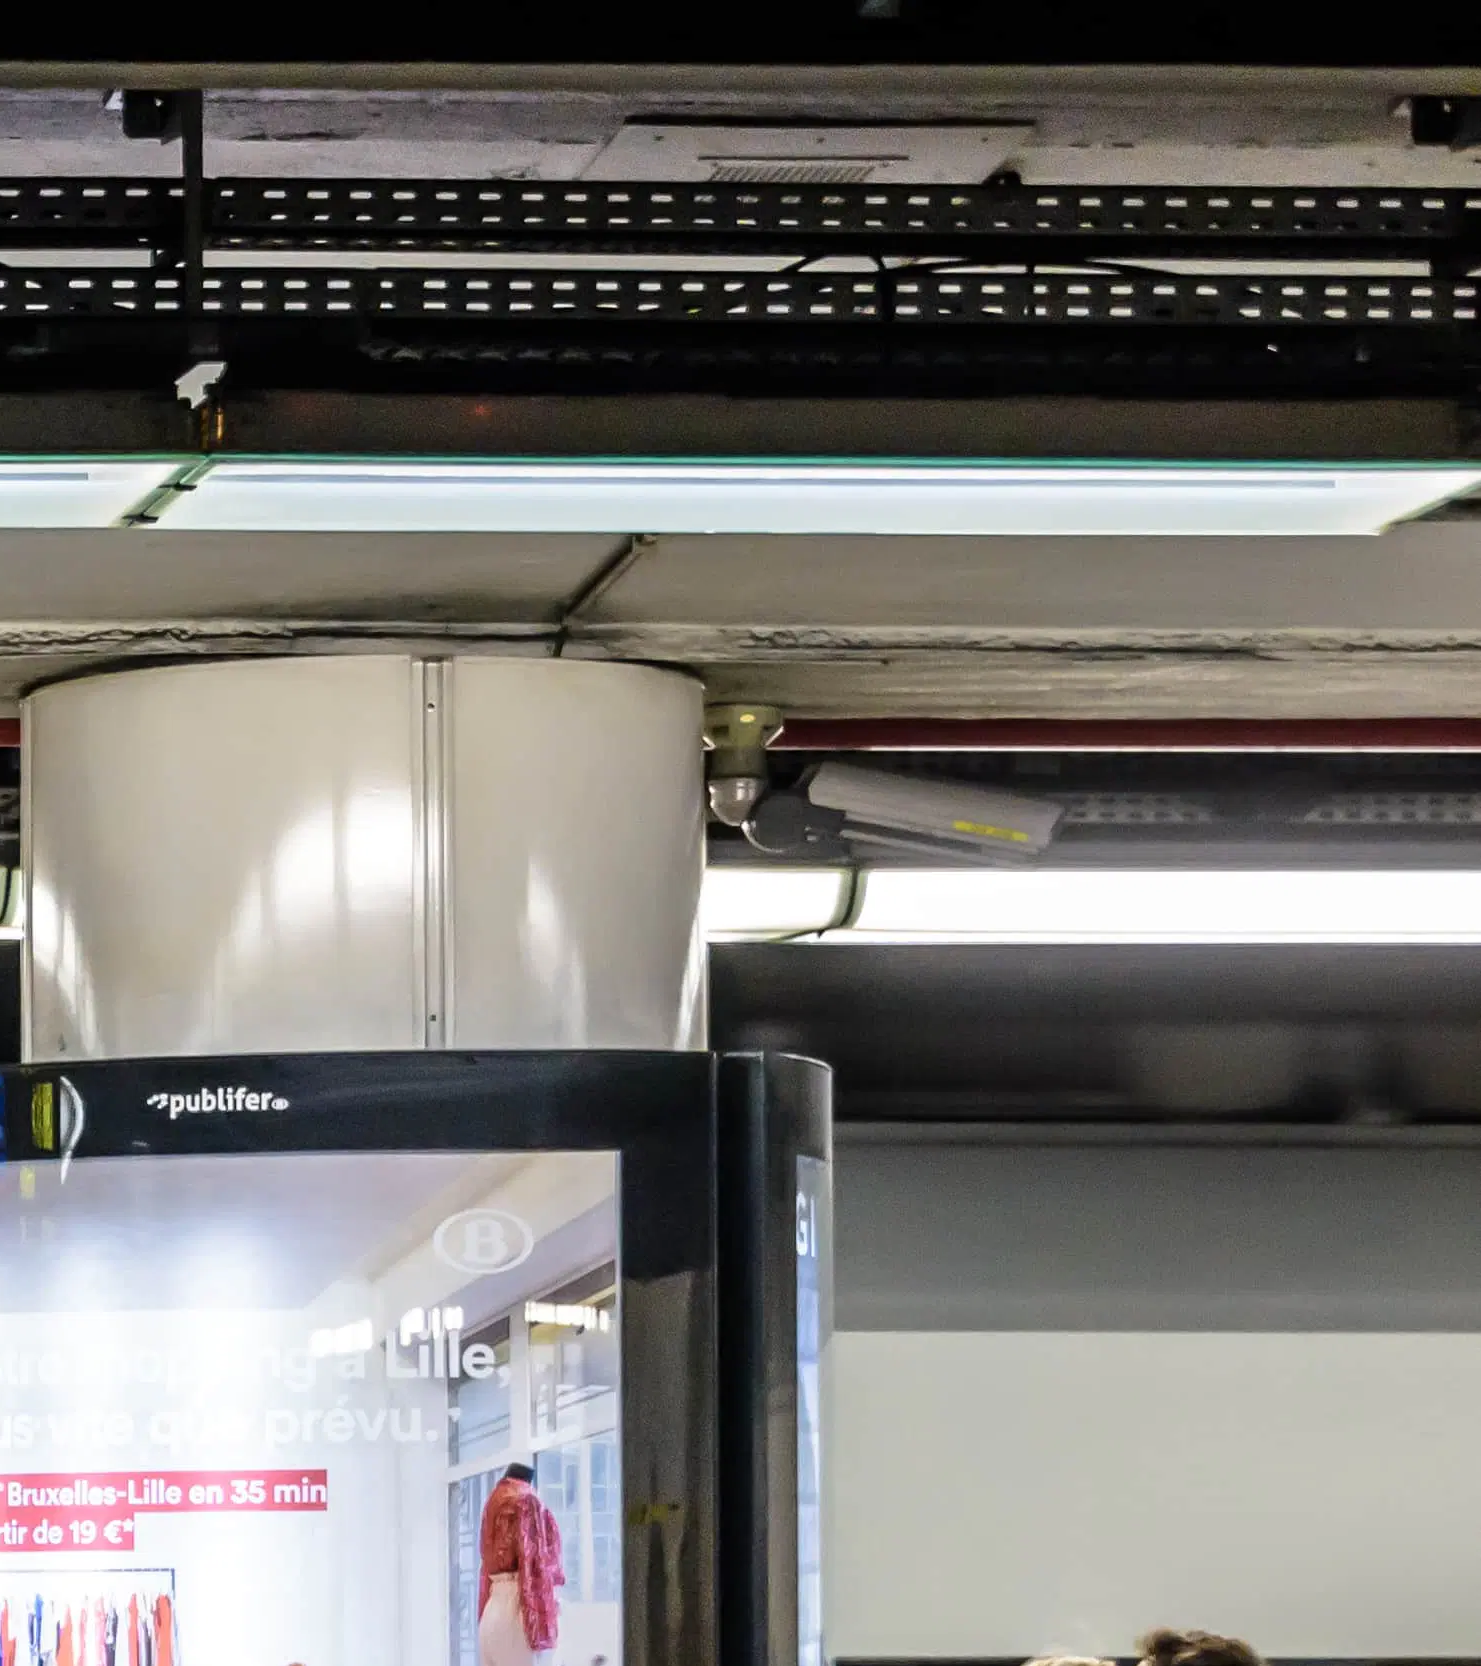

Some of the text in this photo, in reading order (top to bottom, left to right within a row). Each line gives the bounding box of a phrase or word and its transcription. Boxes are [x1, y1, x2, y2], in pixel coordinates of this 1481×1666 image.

[169, 1086, 274, 1120] publifer
[7, 1480, 182, 1506] Bruxelles-Lille
[189, 1485, 223, 1504] en
[230, 1479, 266, 1504] 35
[273, 1477, 327, 1503] min
[32, 1519, 63, 1545] de
[69, 1519, 97, 1544] 19
